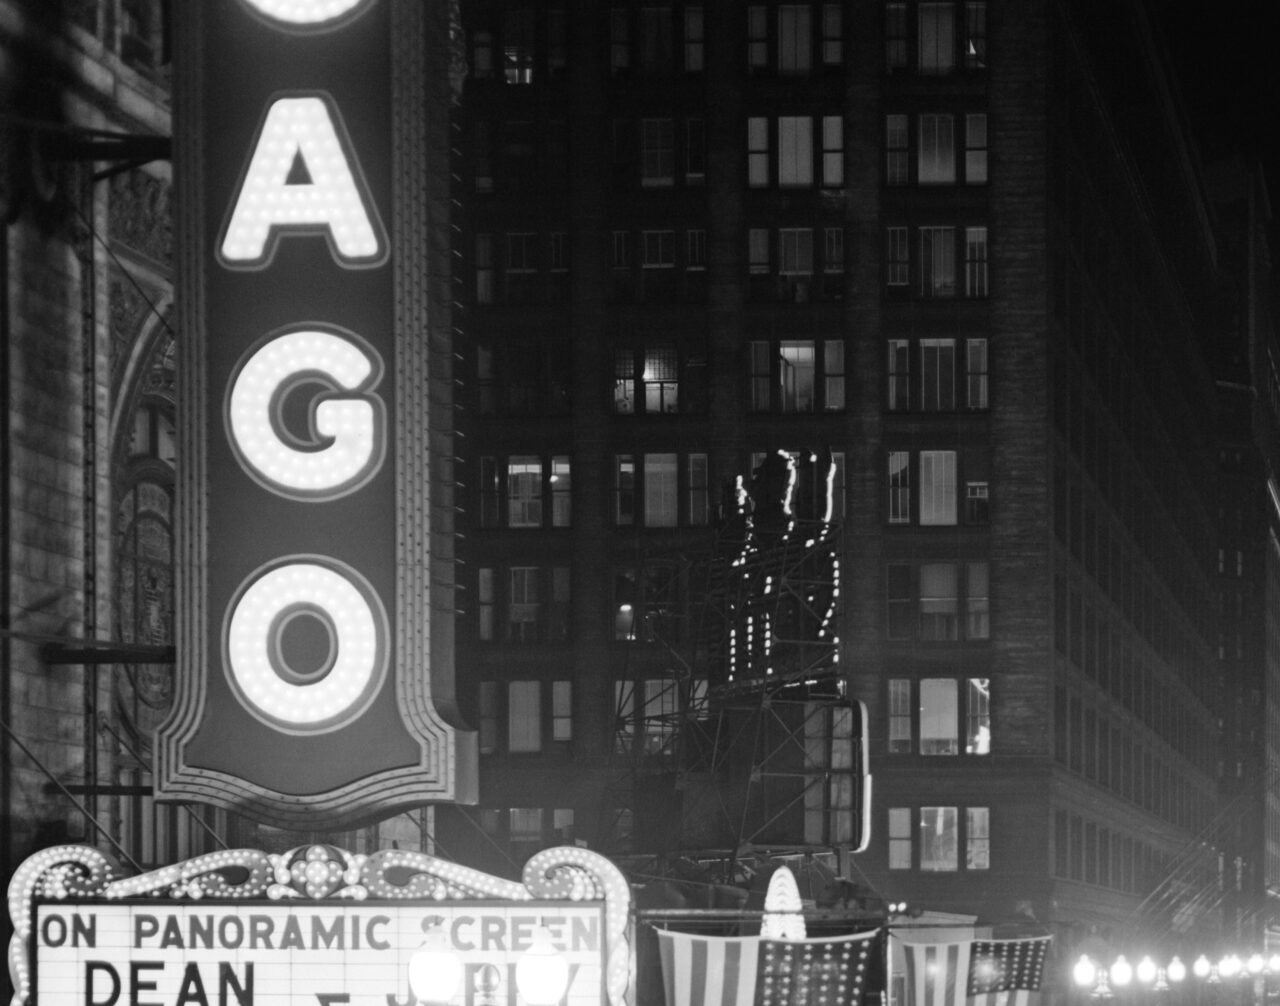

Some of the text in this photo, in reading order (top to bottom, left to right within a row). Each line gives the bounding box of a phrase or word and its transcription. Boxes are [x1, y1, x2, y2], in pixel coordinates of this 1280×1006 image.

[219, 0, 384, 725] AGO
[41, 914, 97, 948] ON
[133, 914, 392, 951] PANORAMIC
